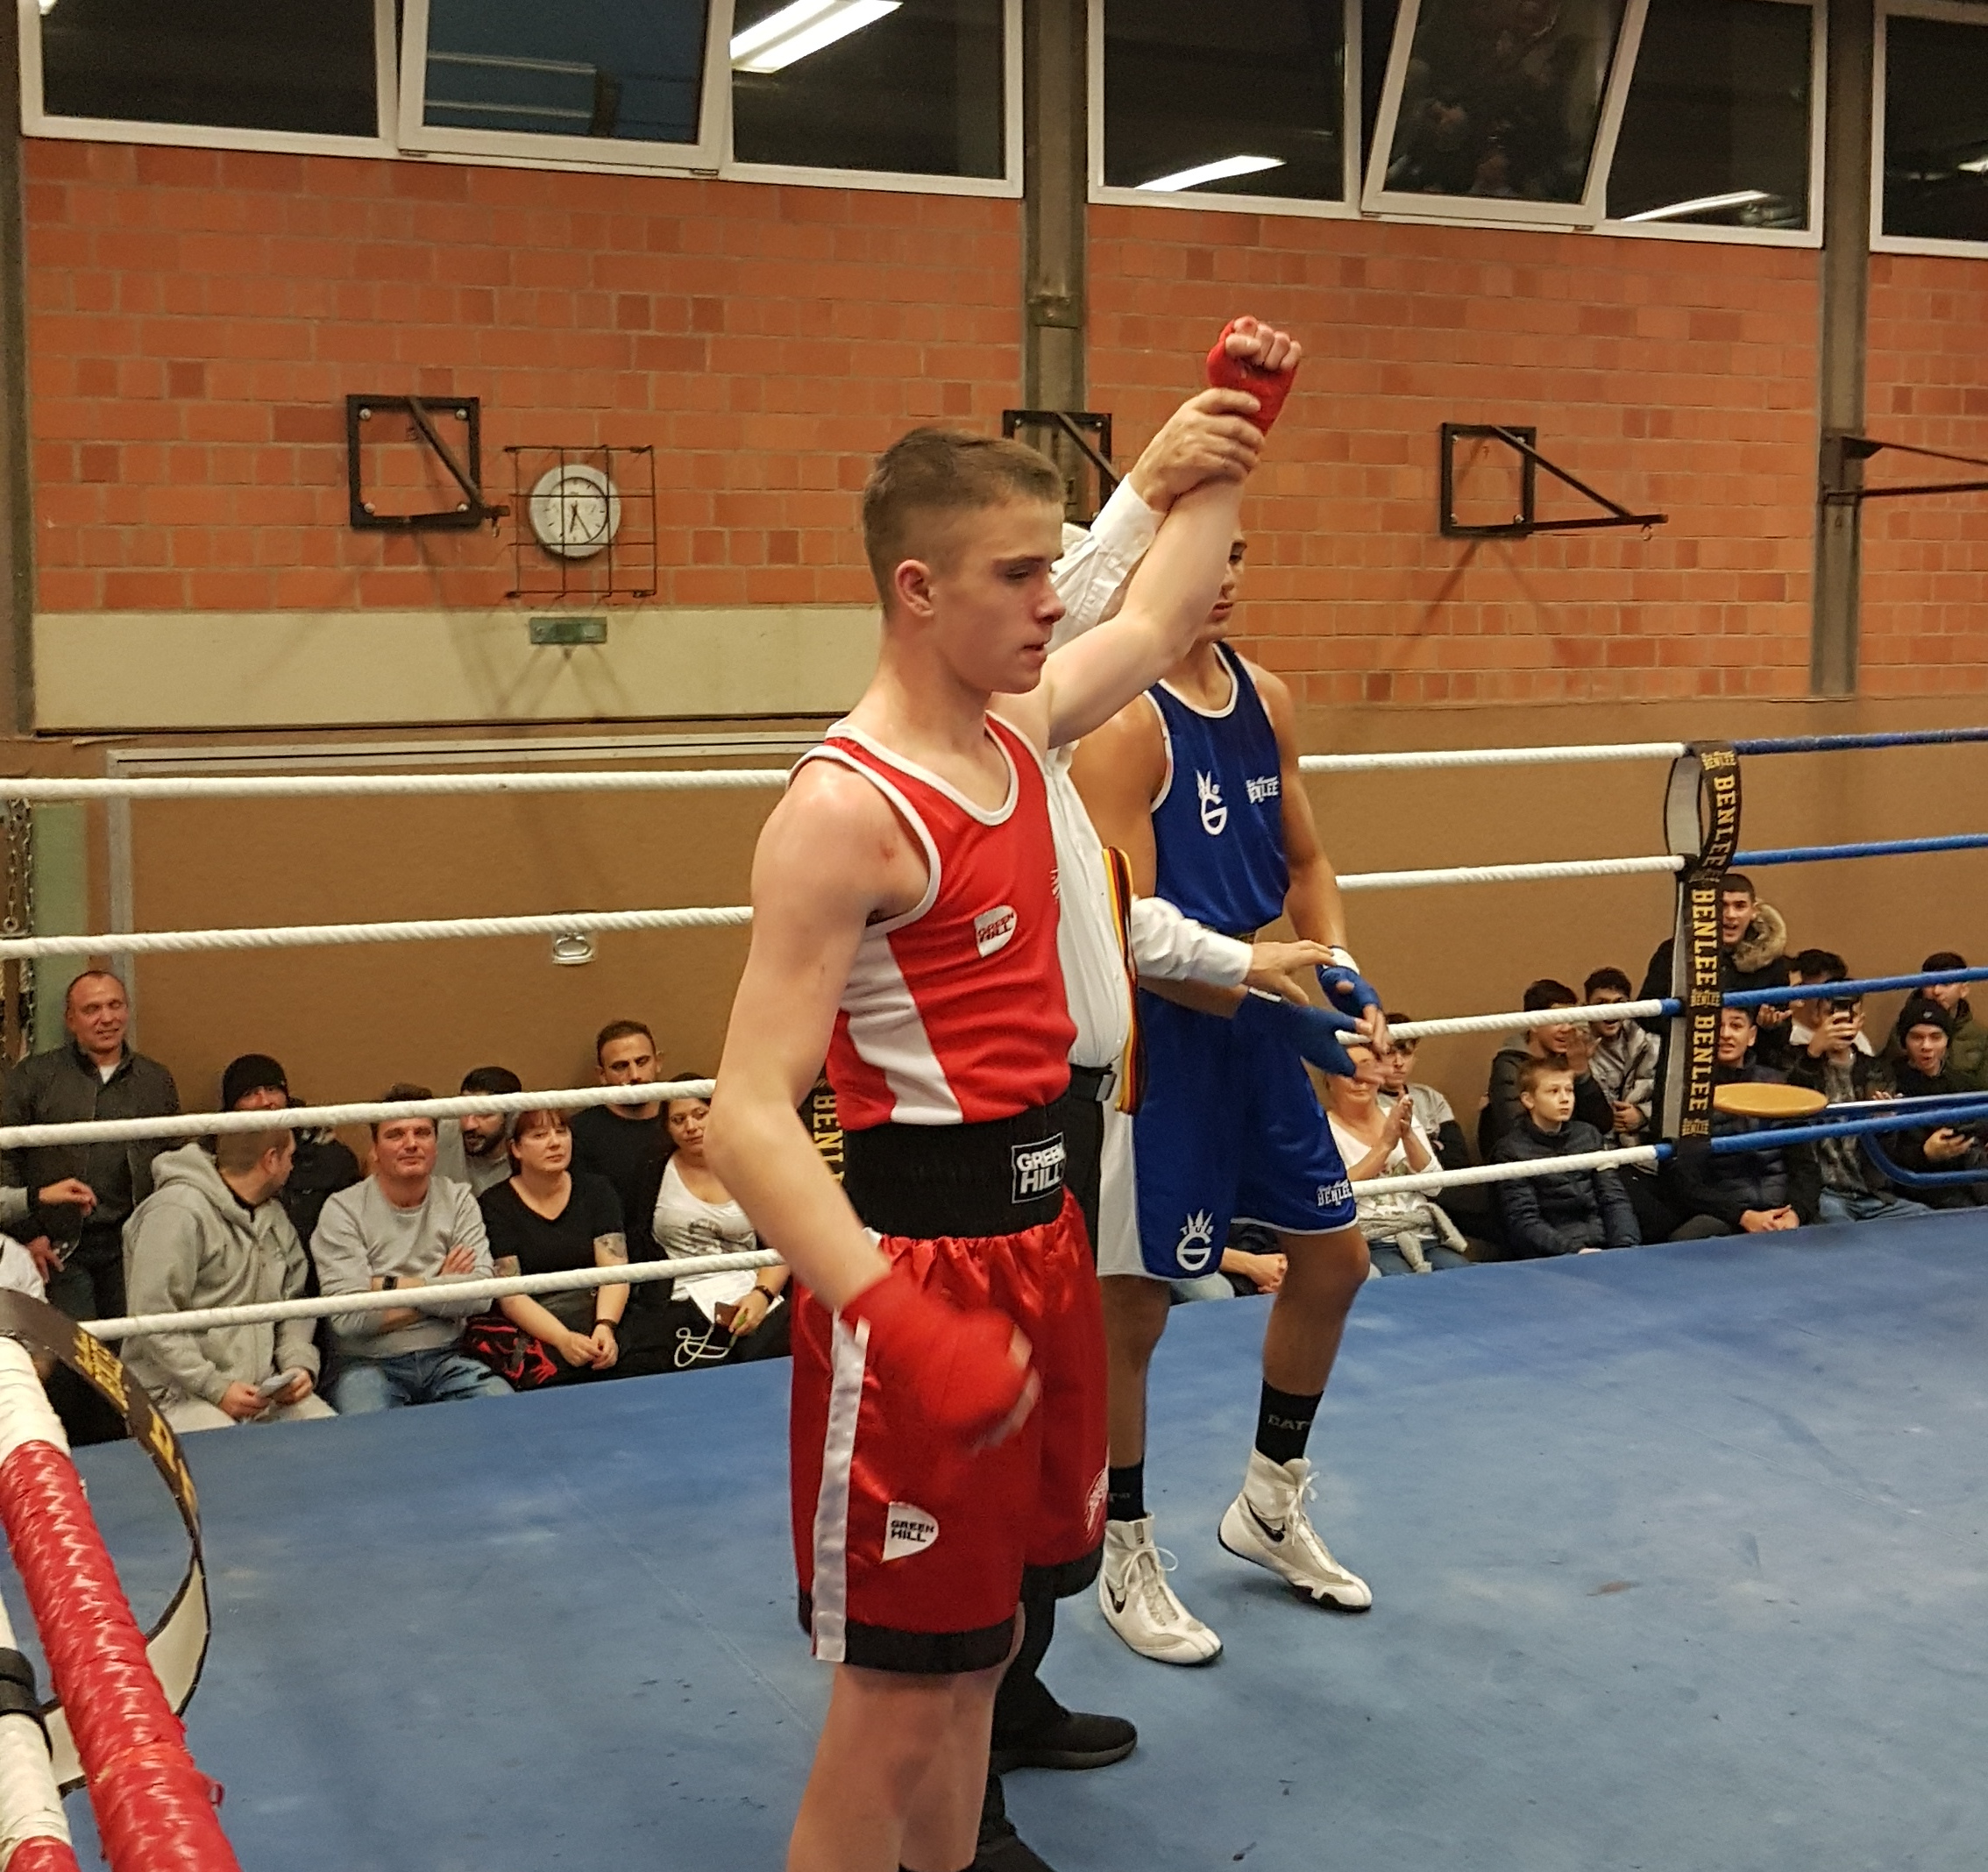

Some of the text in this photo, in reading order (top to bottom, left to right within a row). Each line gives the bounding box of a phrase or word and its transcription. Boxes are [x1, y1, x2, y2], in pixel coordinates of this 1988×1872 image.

[1702, 773, 1736, 868] BENLEE
[1691, 888, 1718, 987] BENLEE
[1688, 1014, 1715, 1112] BENLEE
[813, 1094, 846, 1182] BENL
[1019, 1163, 1061, 1194] HILL
[1317, 1186, 1353, 1207] BENLEE
[891, 1520, 935, 1533] GREEN
[891, 1528, 927, 1543] HILL
